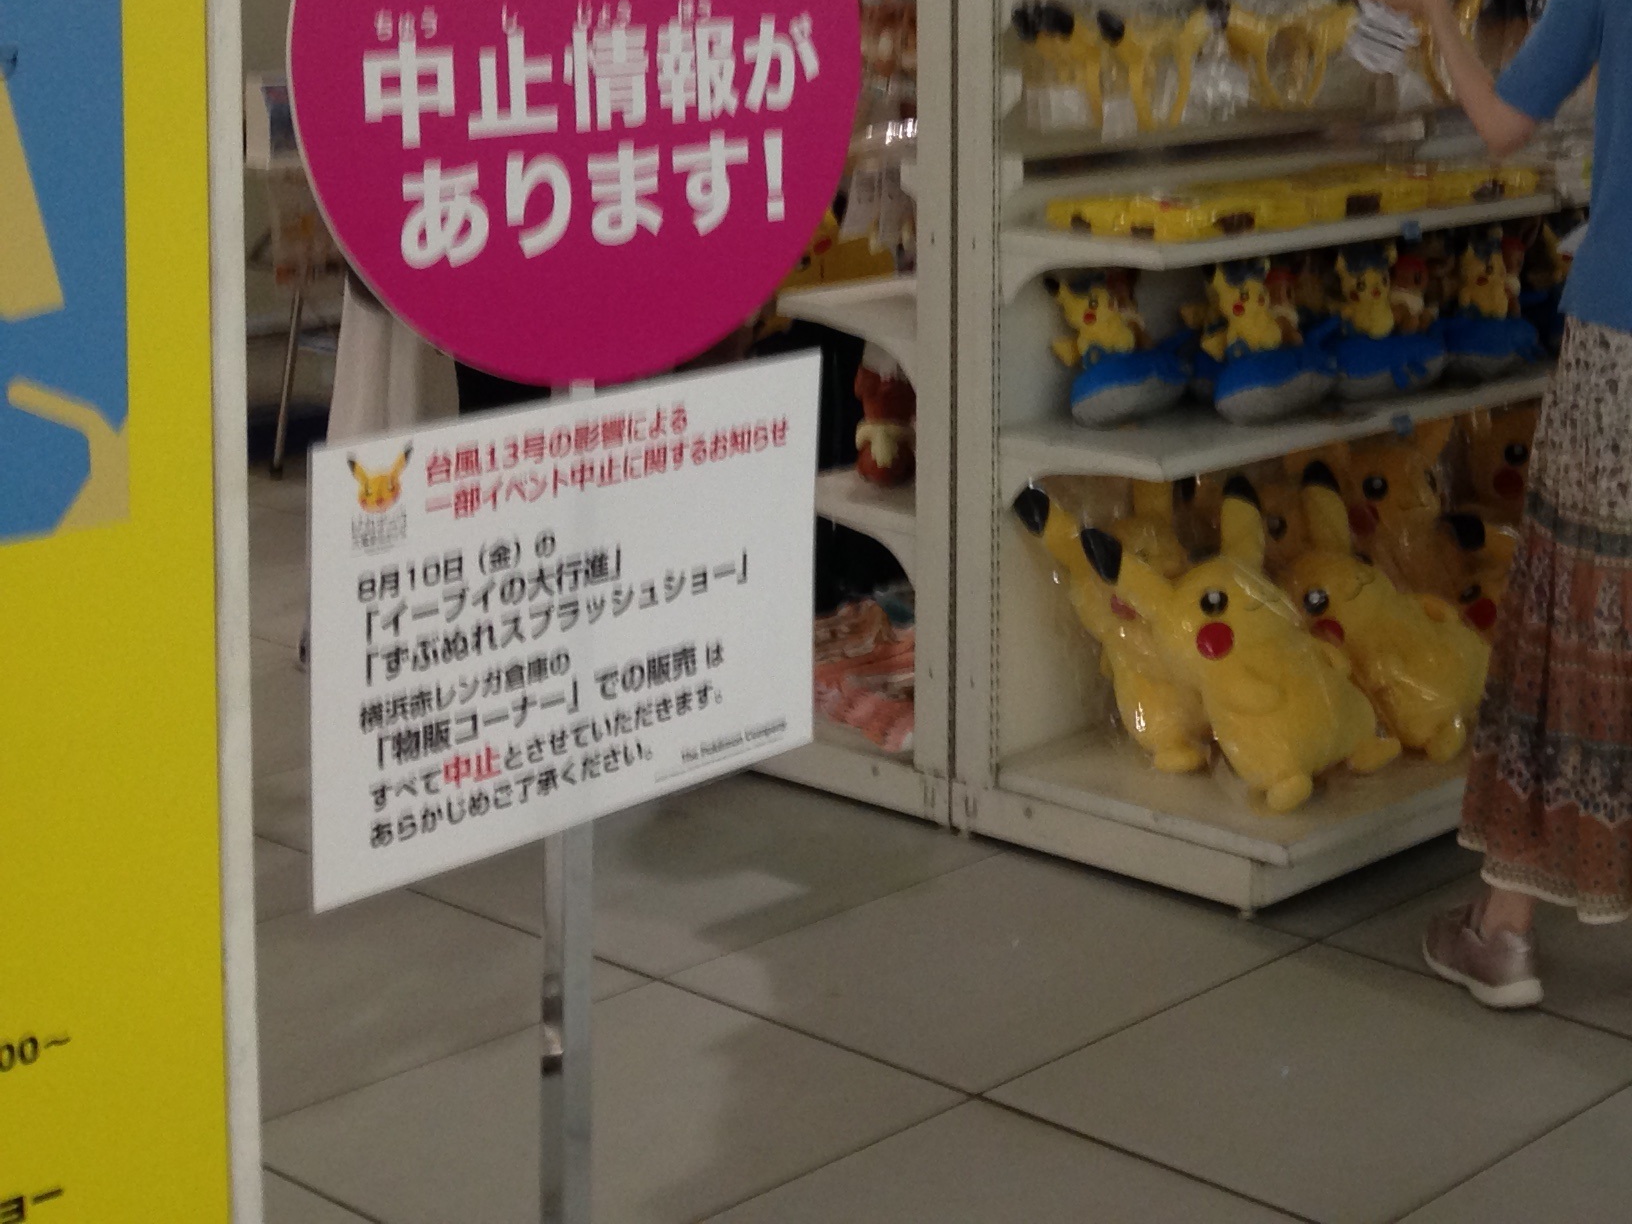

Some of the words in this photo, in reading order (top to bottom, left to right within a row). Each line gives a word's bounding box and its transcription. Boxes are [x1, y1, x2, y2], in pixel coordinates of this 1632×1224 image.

[362, 11, 820, 149] 中止情報が
[425, 413, 789, 519] 一部イベント中止に関するお知らせ
